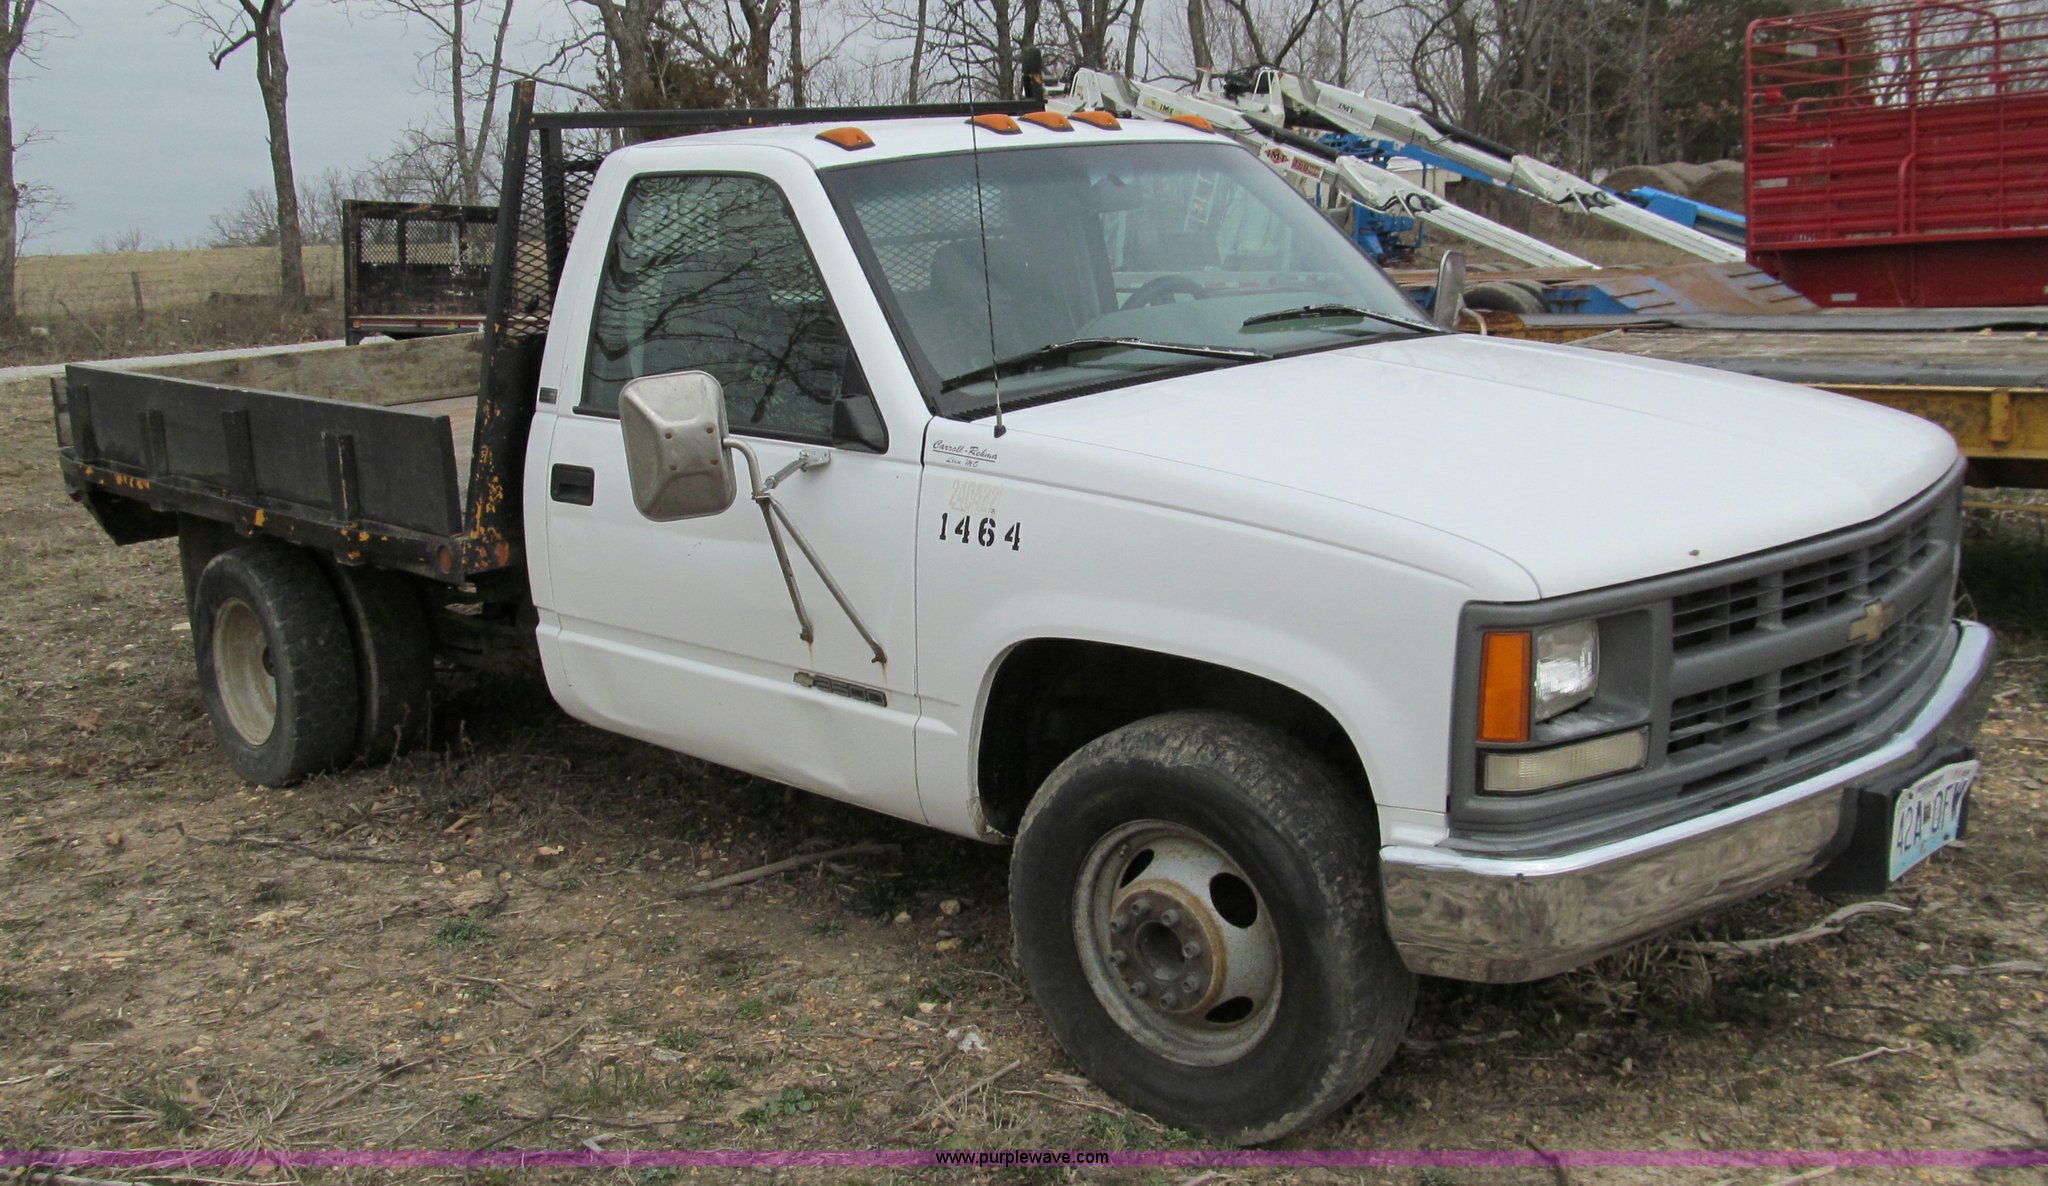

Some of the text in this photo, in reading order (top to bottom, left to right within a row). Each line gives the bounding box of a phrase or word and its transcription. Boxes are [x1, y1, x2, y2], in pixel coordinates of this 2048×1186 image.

[1338, 102, 1354, 114] IMT
[1265, 149, 1287, 163] IMT
[939, 512, 1021, 551] 1464
